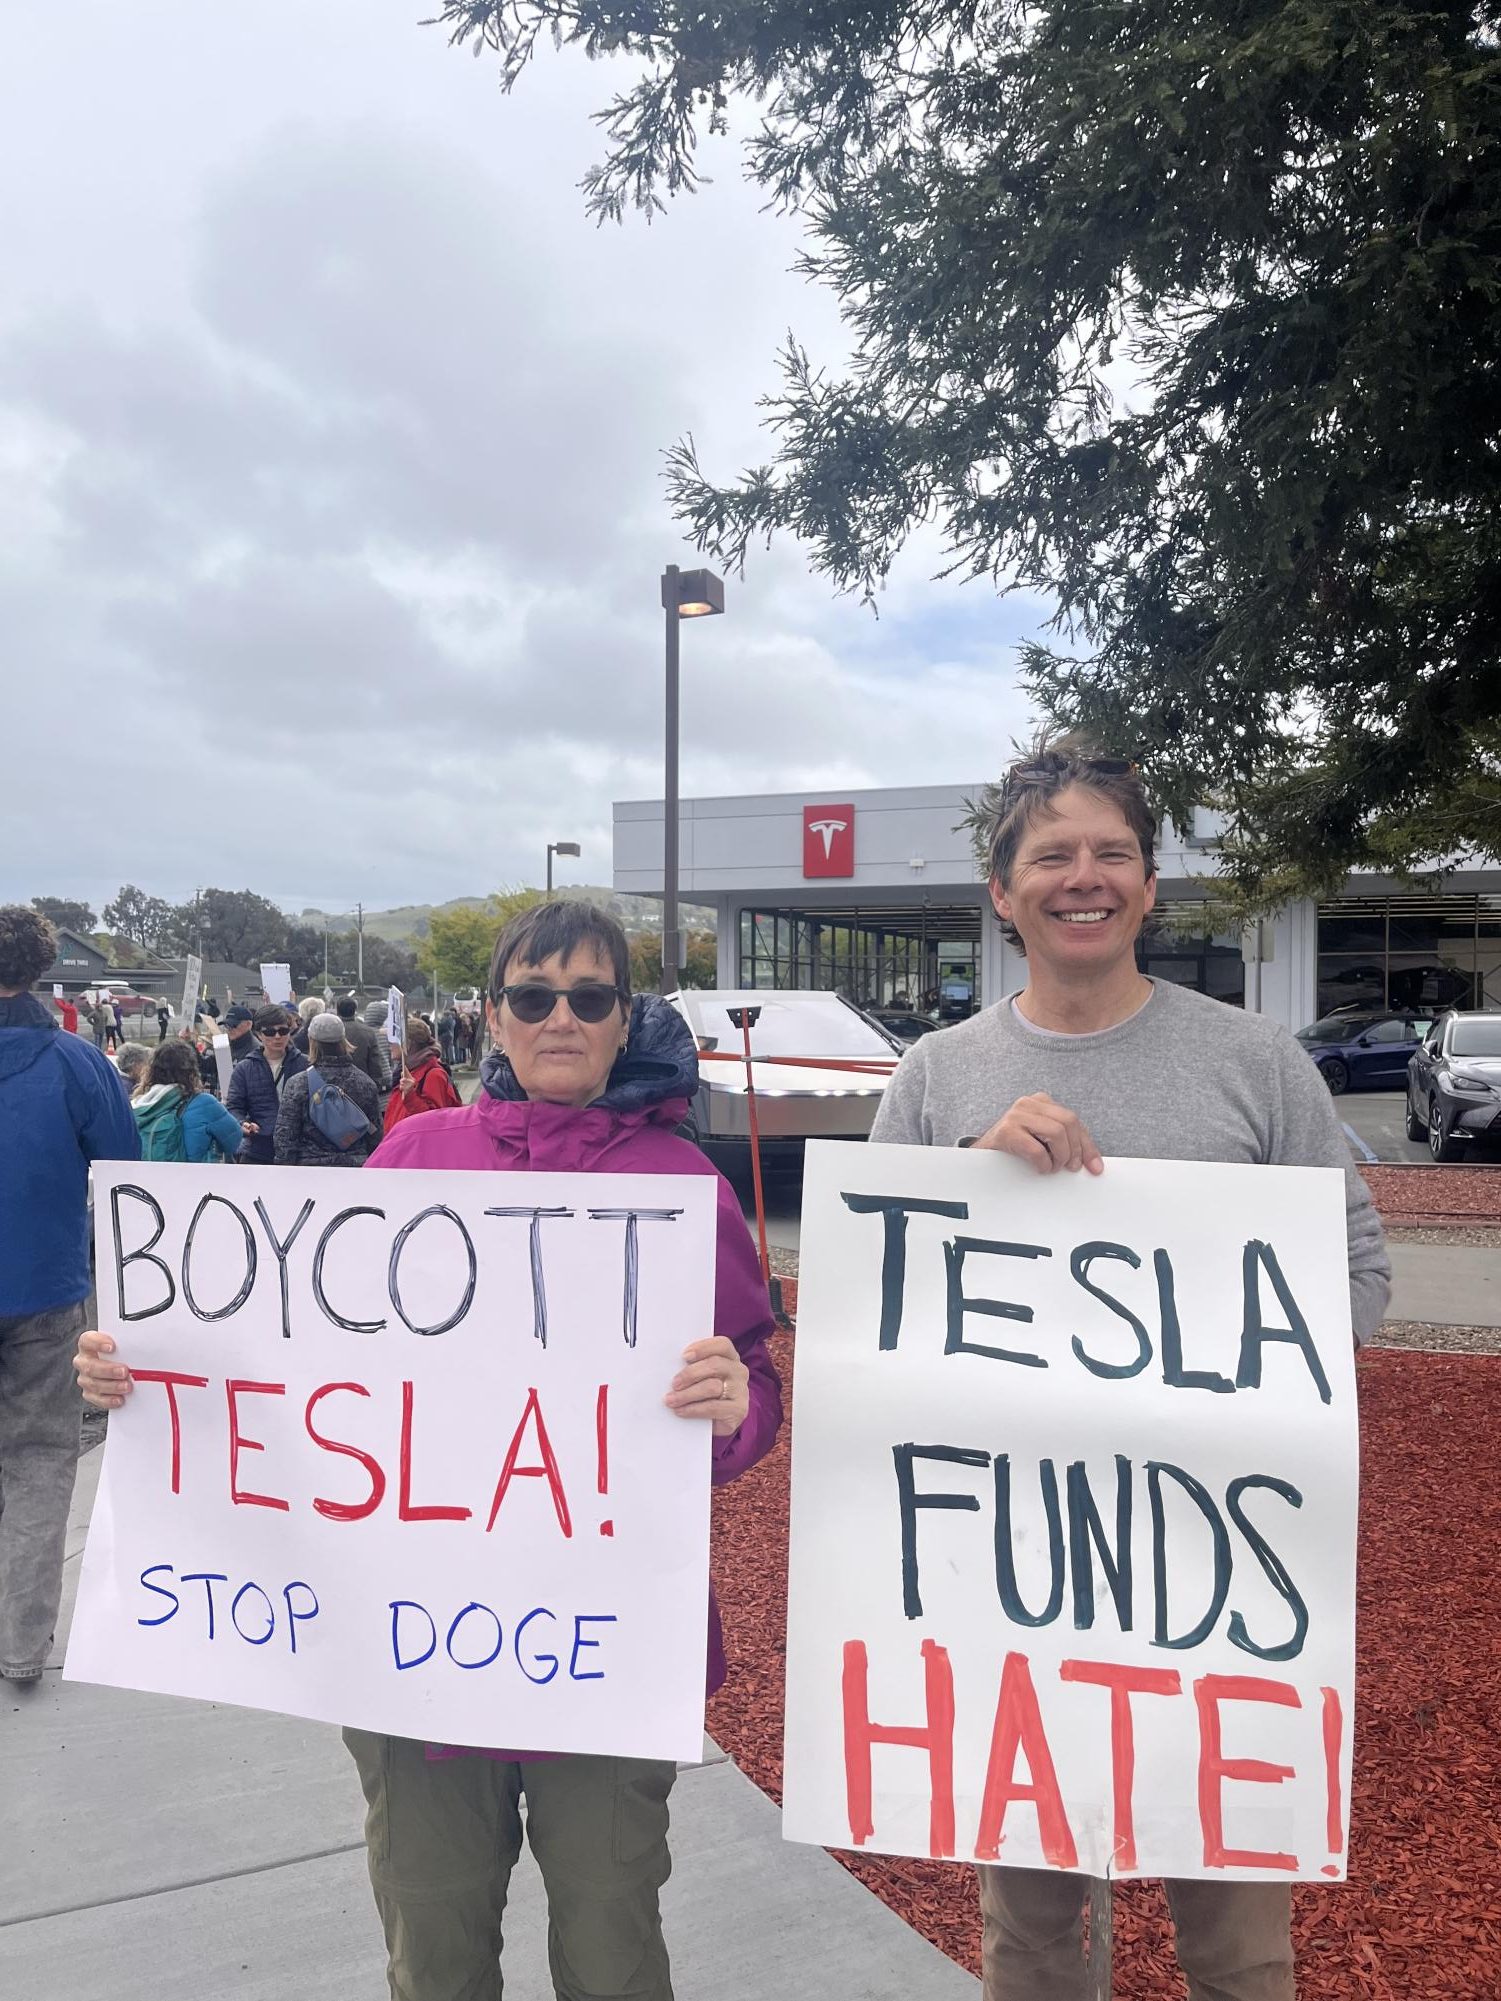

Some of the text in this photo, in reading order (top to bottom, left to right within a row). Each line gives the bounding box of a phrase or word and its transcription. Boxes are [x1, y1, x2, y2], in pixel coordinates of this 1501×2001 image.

[110, 1183, 685, 1350] BOYCOTT
[839, 1191, 1332, 1405] TESLA
[130, 1369, 614, 1539] TESLA!
[138, 1564, 617, 1685] STOP DOGE
[891, 1442, 1309, 1662] FUNDS
[842, 1638, 1342, 1878] HATE!
